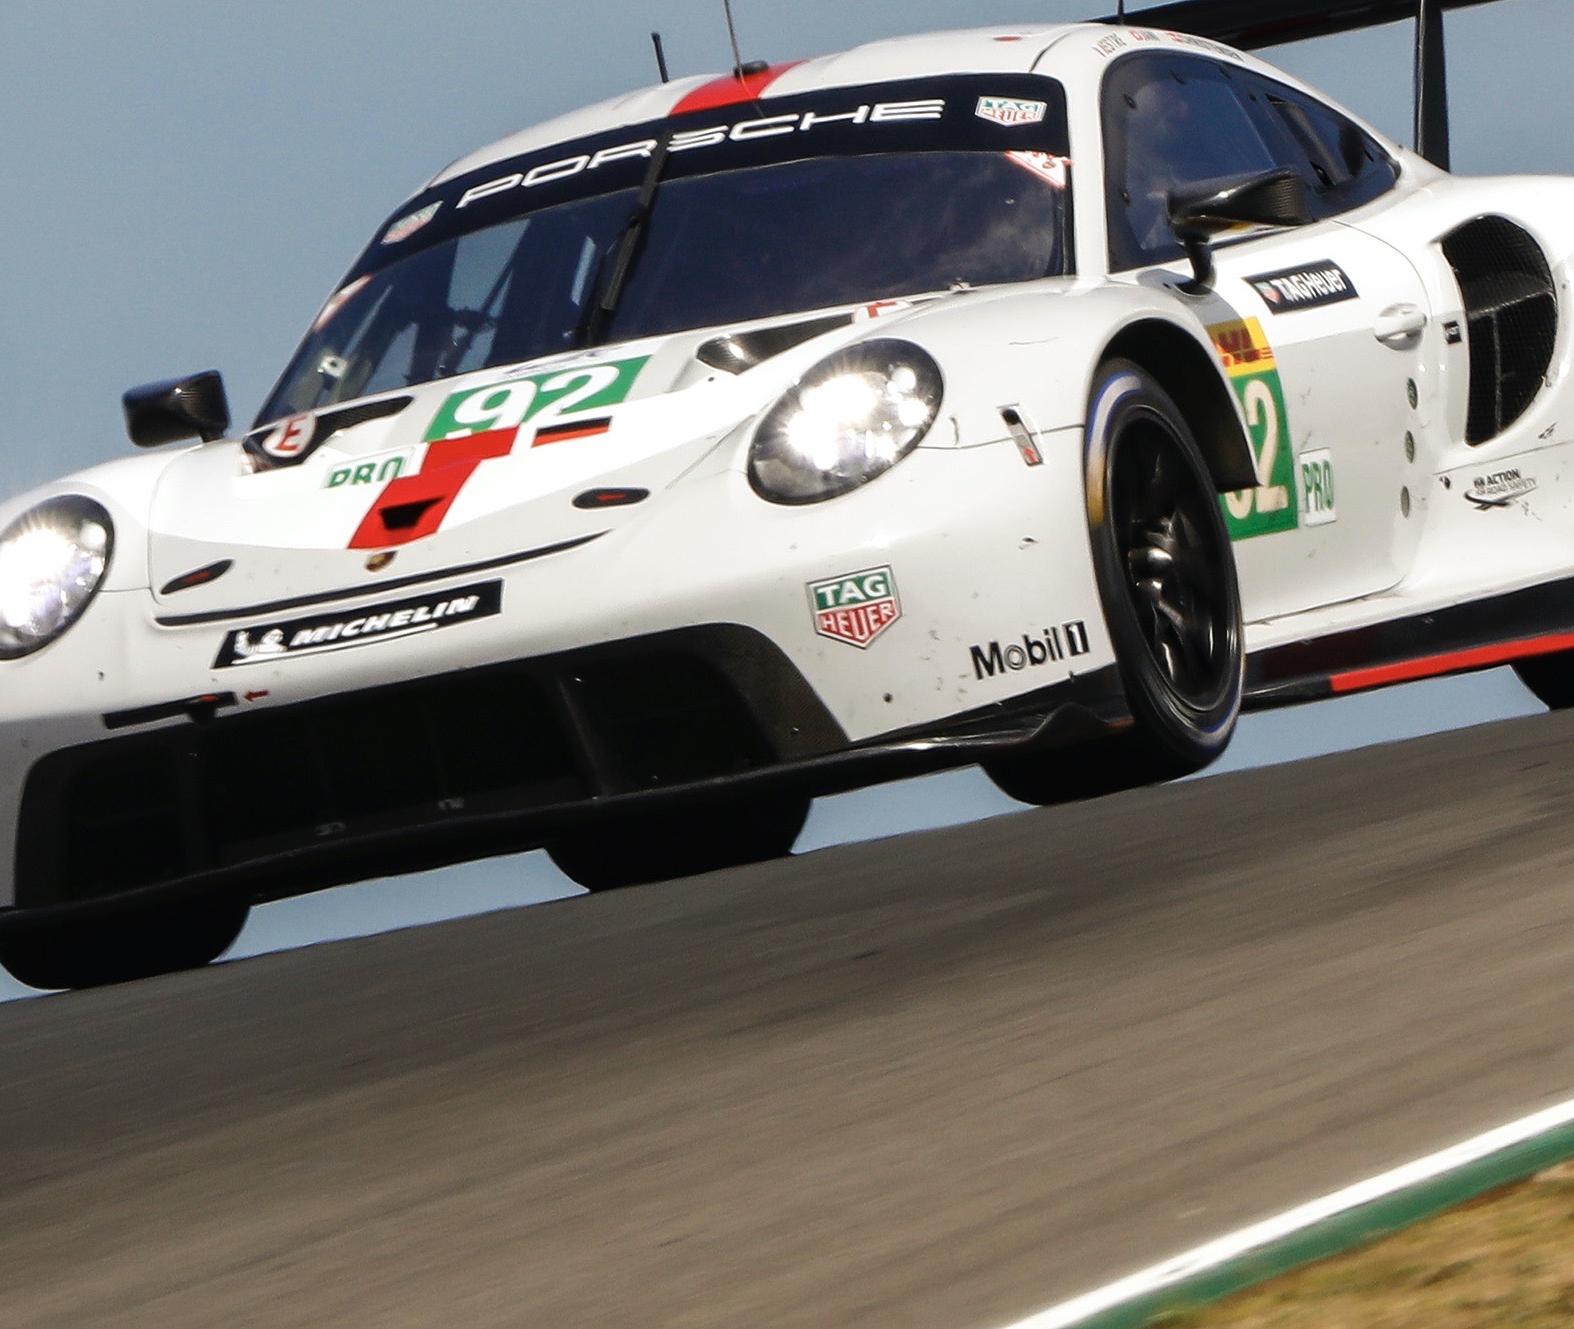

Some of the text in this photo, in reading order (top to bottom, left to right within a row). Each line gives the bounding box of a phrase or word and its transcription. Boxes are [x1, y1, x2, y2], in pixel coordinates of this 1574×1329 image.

[981, 98, 1041, 112] TAG
[455, 99, 946, 209] PORSCHE
[445, 364, 622, 441] 92
[274, 414, 309, 452] E
[1224, 378, 1289, 520] 2
[1301, 459, 1335, 514] PRO
[1486, 468, 1521, 485] ACTION
[816, 573, 890, 610] TAG
[288, 594, 481, 647] MICHELIN
[818, 602, 895, 640] HEUER
